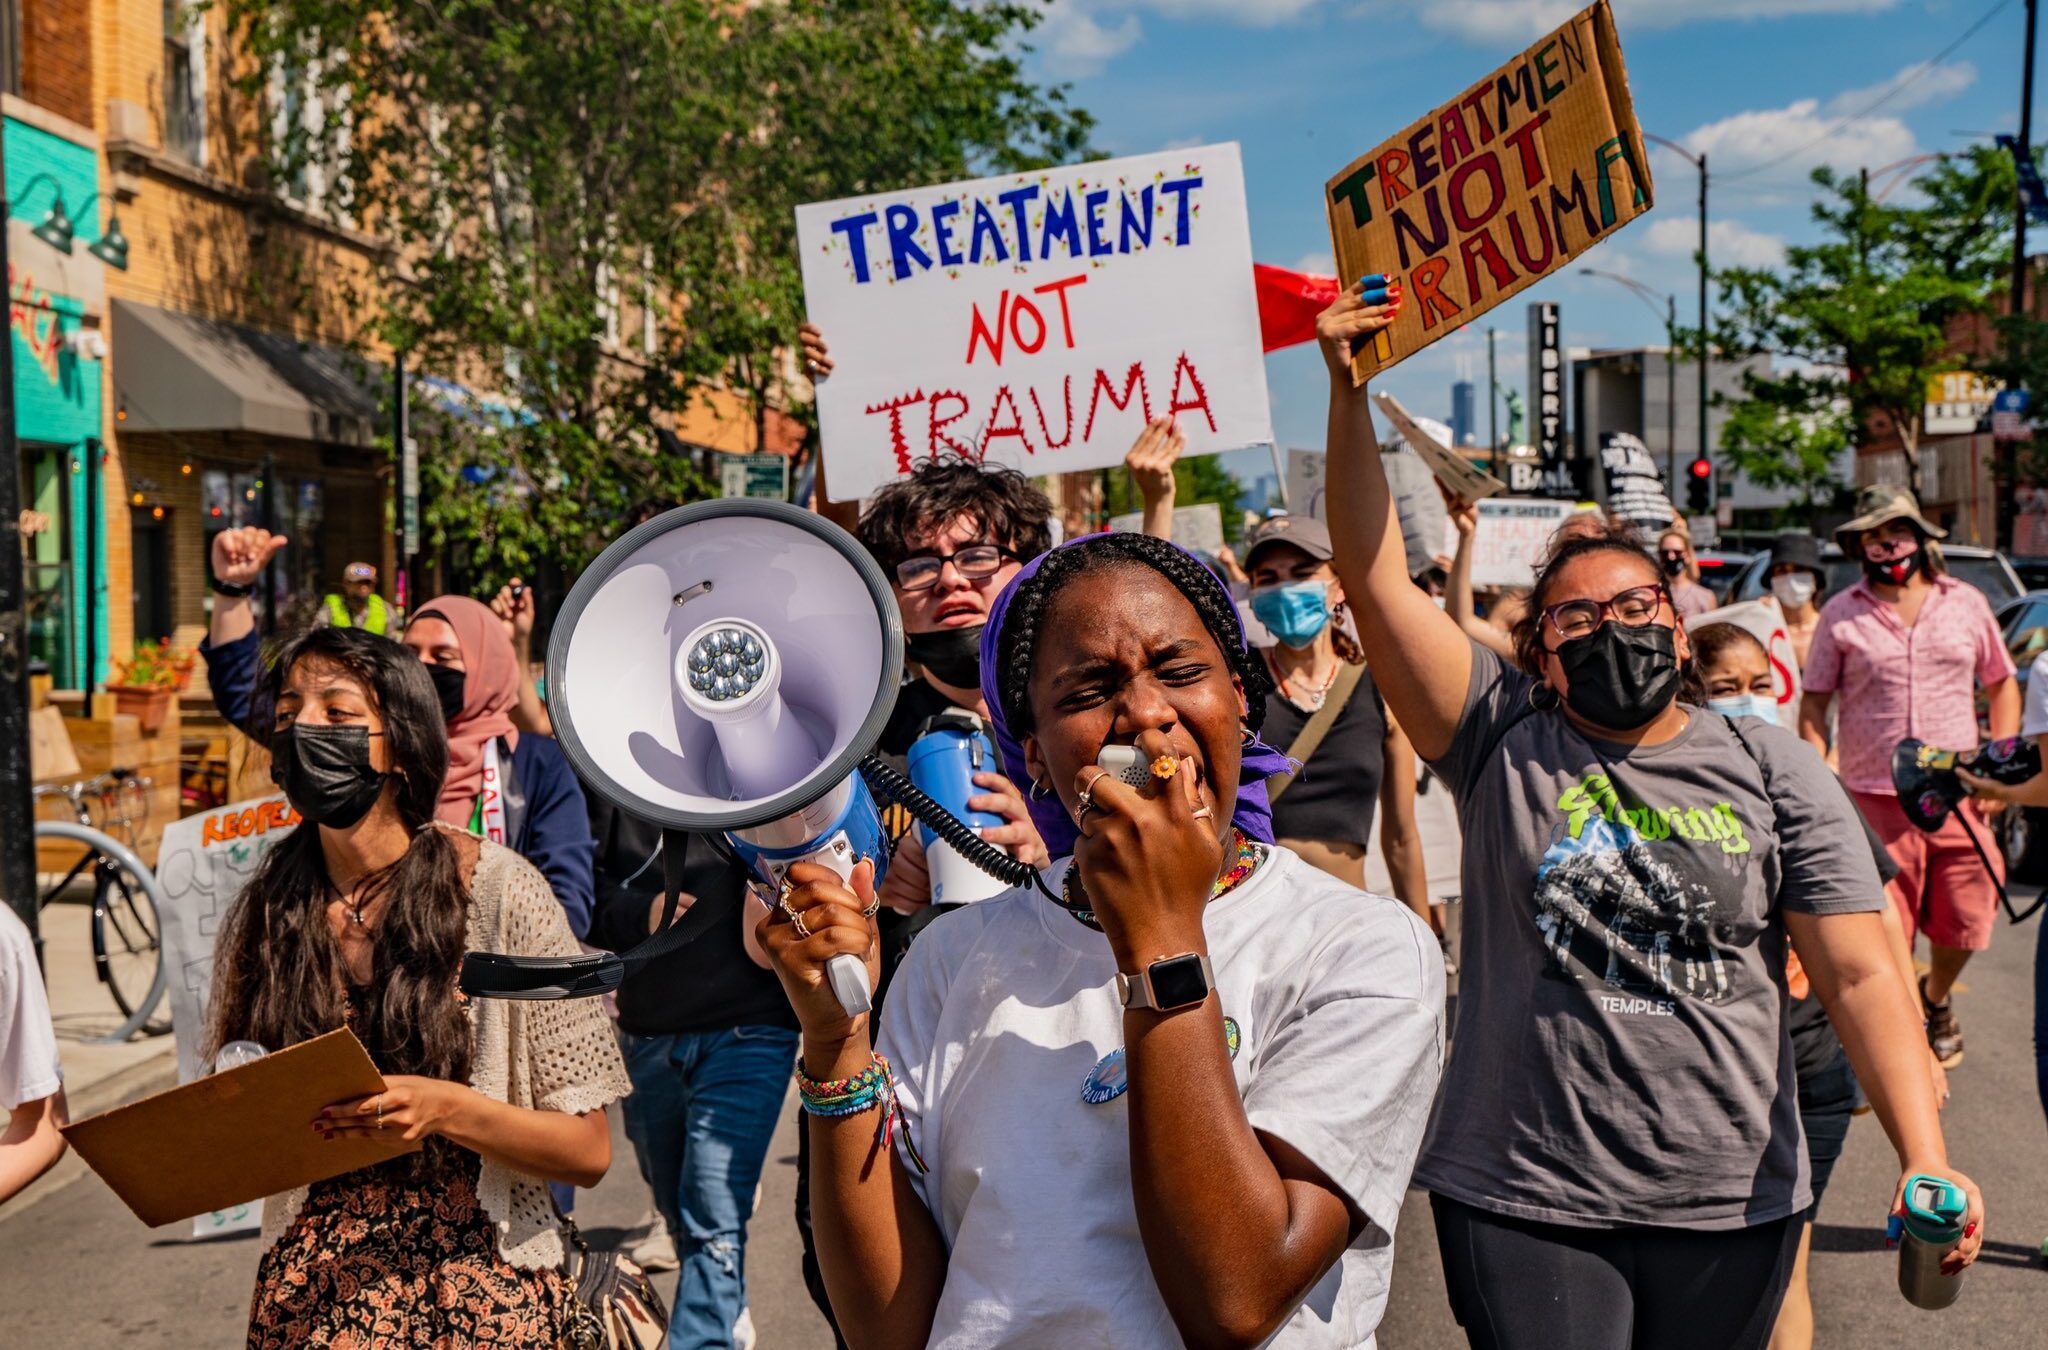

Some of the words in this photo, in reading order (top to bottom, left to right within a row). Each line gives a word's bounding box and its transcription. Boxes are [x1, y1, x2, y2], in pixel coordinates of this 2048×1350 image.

[830, 176, 1203, 284] TREATMENT
[1392, 110, 1550, 270] NOT
[966, 274, 1087, 367] NOT
[865, 350, 1217, 473] TRAUMA
[1542, 303, 1559, 459] LIBERTY
[1600, 996, 1676, 1016] TEMPLES
